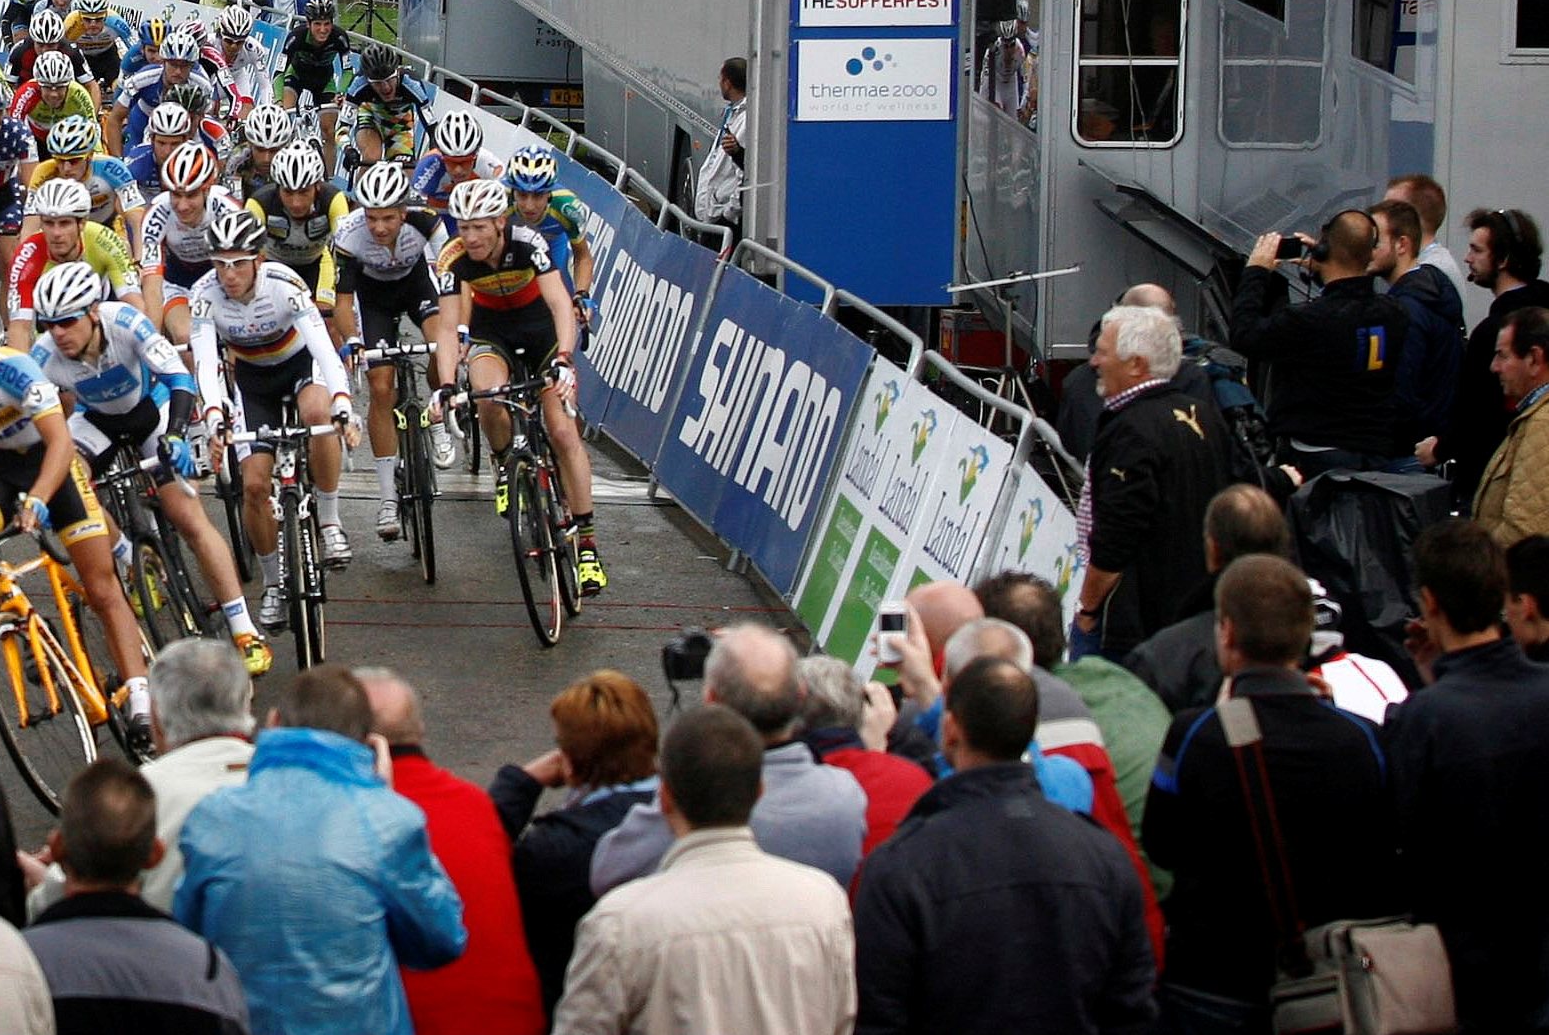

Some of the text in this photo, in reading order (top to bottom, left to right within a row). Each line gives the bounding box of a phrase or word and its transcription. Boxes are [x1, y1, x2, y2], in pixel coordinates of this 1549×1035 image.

[809, 83, 938, 98] thermae 2000
[678, 317, 843, 534] SHIMANO
